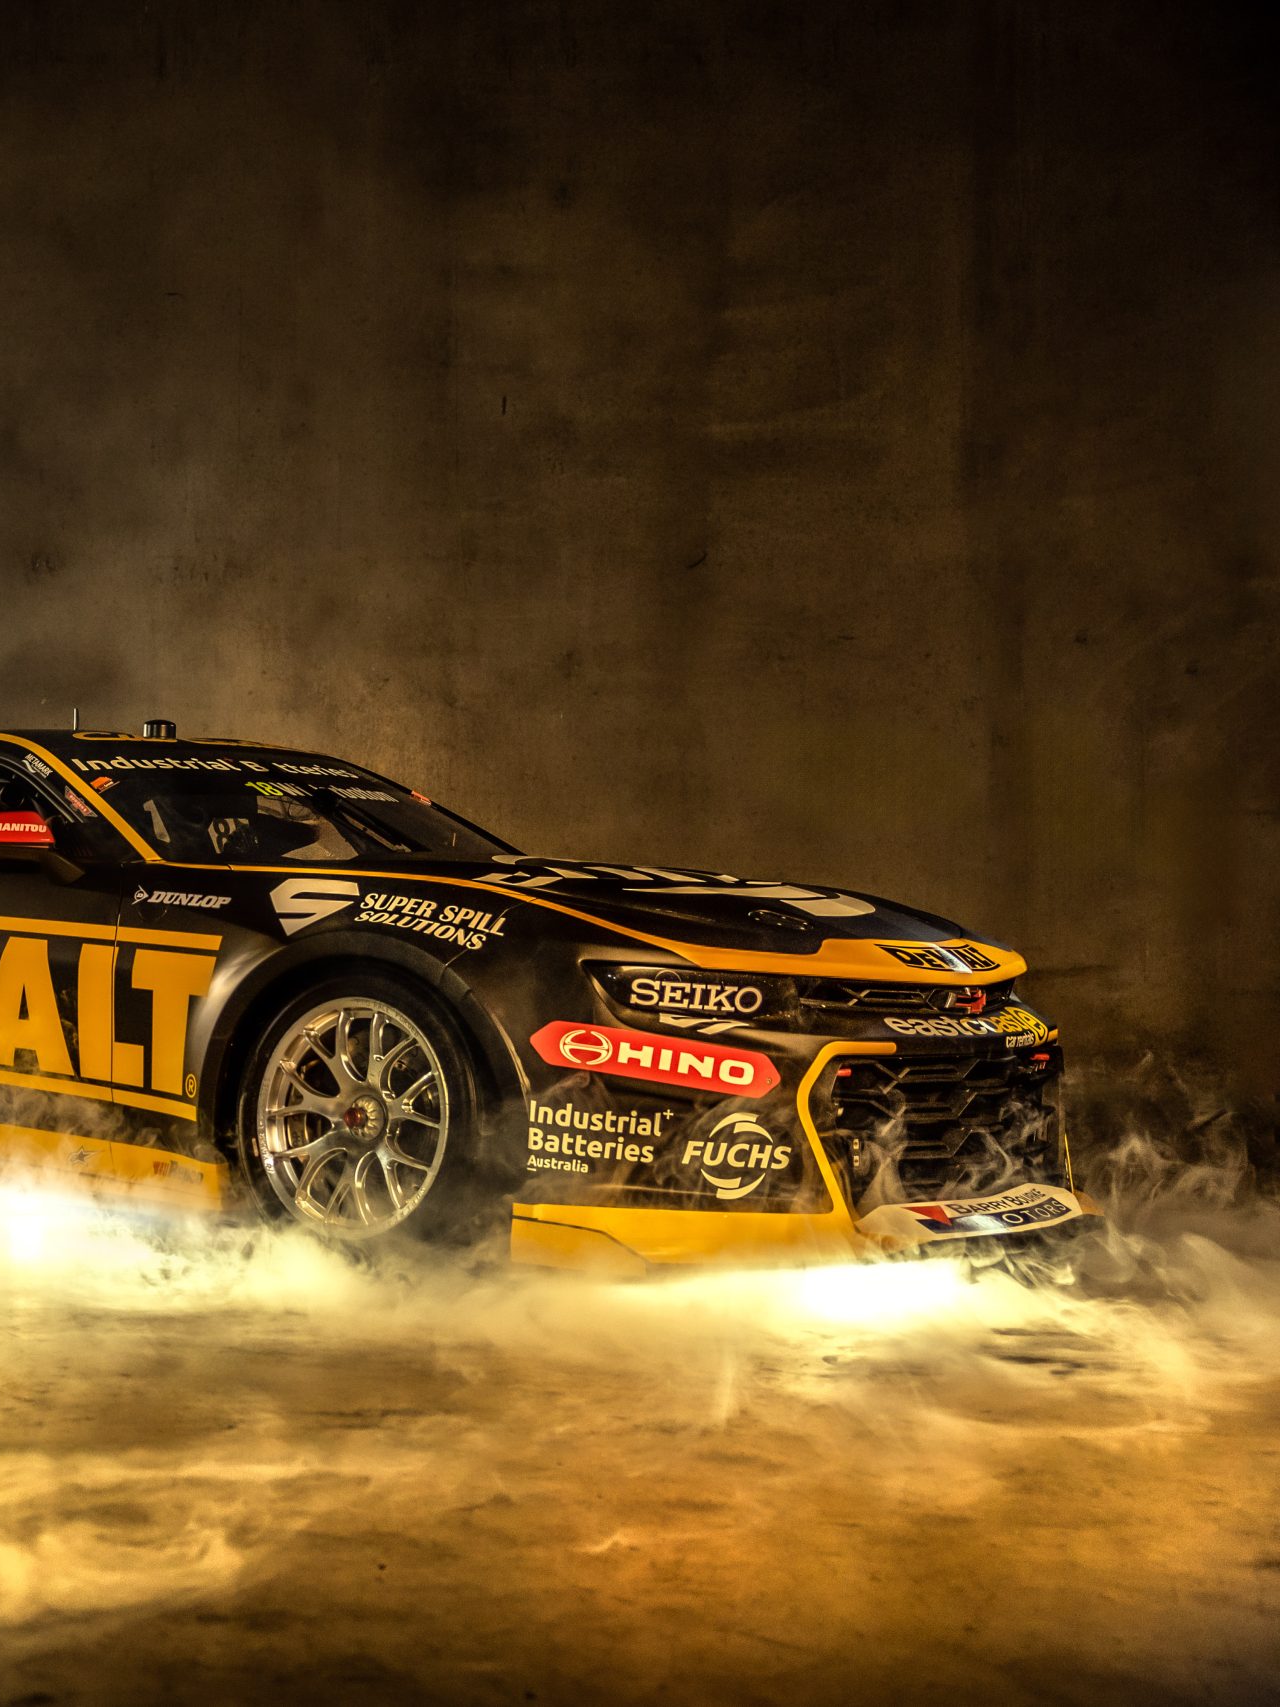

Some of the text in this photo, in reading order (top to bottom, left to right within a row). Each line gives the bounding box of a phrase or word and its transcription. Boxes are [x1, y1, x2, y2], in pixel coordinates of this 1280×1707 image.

[24, 753, 54, 777] METAMARK
[72, 756, 360, 779] Industrial Btteries
[245, 781, 283, 796] 18
[147, 890, 232, 909] DUNLOP
[360, 892, 505, 937] SUPER SPILL
[353, 910, 487, 951] SOLUTIONS
[629, 978, 763, 1013] SEIKO
[883, 1010, 1028, 1037] eastcoast
[1005, 1029, 1035, 1048] car rentals
[617, 1041, 755, 1086] HINO
[527, 1127, 655, 1163] Batteries
[681, 1140, 792, 1170] FUCHS
[527, 1154, 589, 1173] Australia
[946, 1197, 1011, 1215] BARRY
[1002, 1199, 1067, 1225] OTORS
